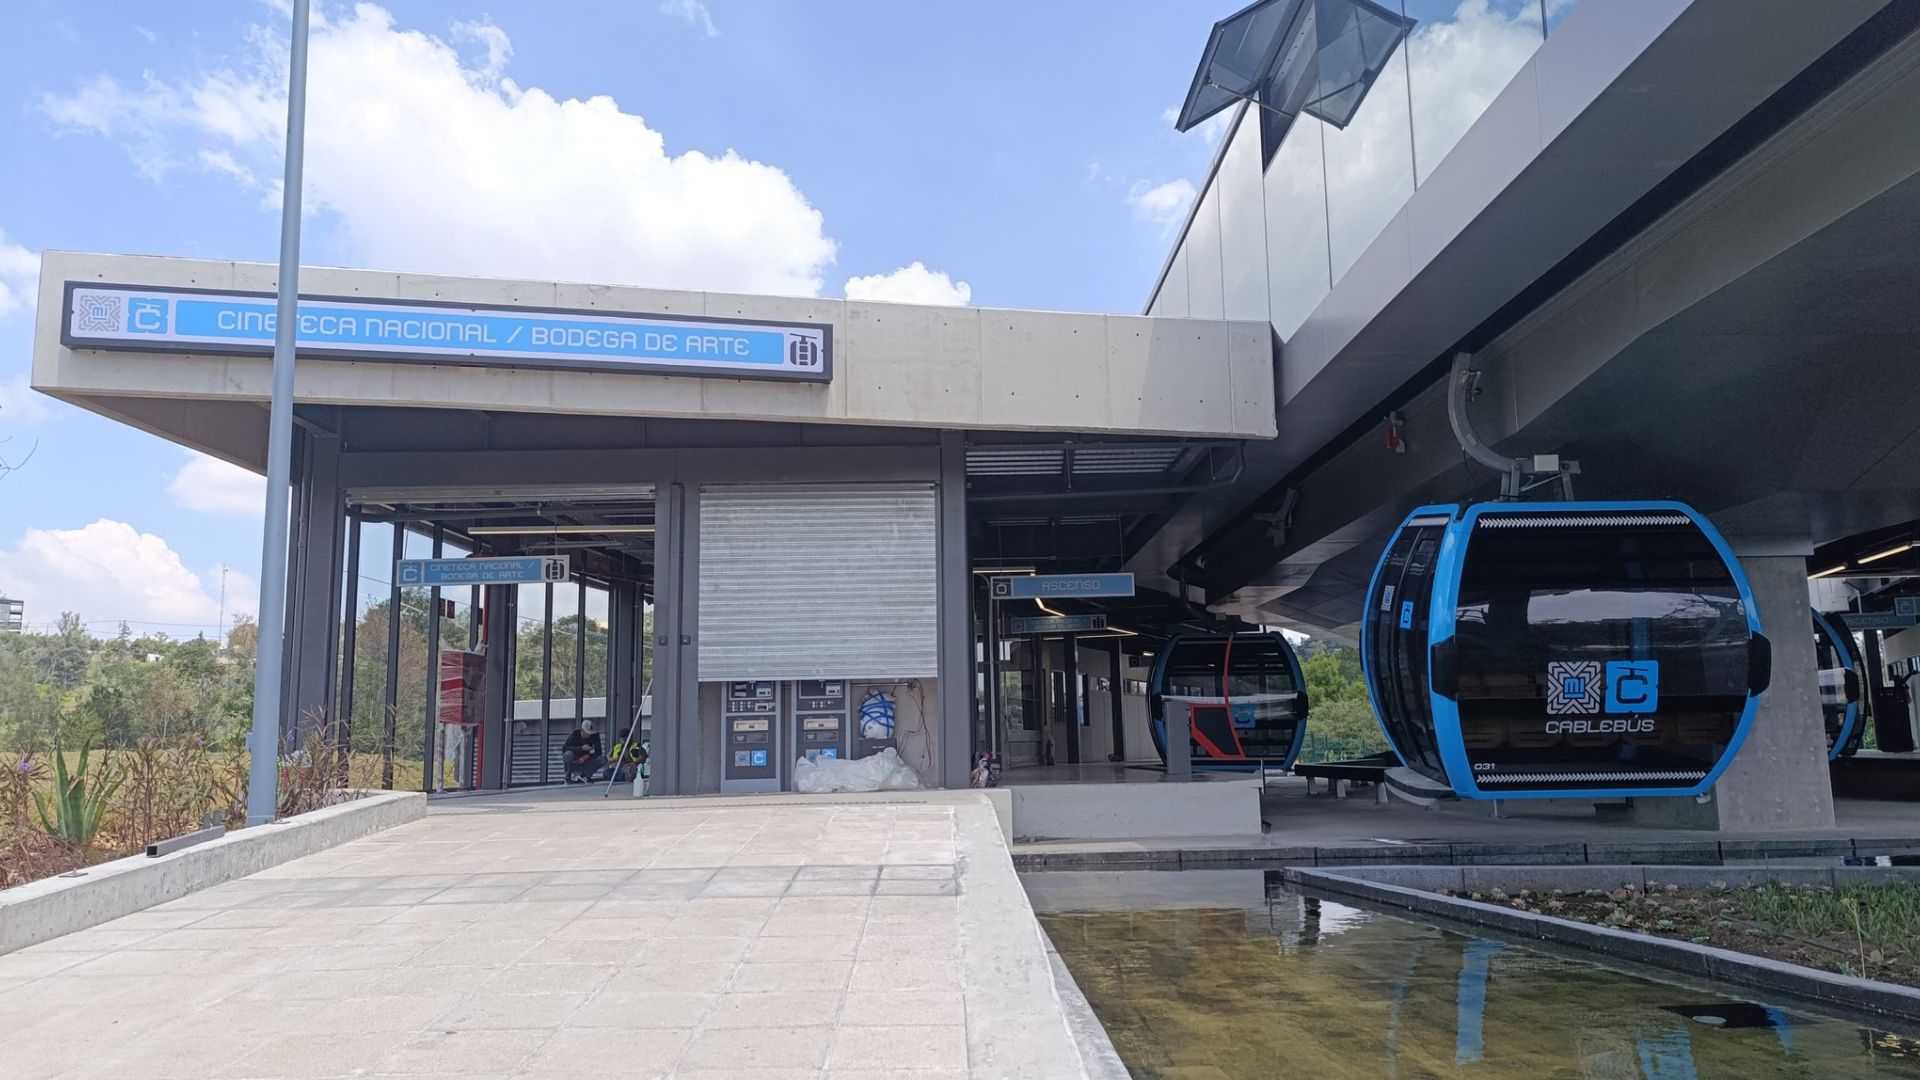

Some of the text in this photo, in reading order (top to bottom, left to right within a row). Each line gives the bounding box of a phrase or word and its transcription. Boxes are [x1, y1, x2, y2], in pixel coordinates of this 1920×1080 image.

[217, 310, 357, 336] CINEECA
[365, 318, 497, 343] NACIONAL
[532, 327, 637, 350] BODEGA
[644, 333, 678, 351] DE
[686, 336, 750, 356] ARTE
[1042, 580, 1100, 592] ASCENSO
[1545, 714, 1655, 734] CABLEBÚS
[1474, 762, 1495, 771] 031
